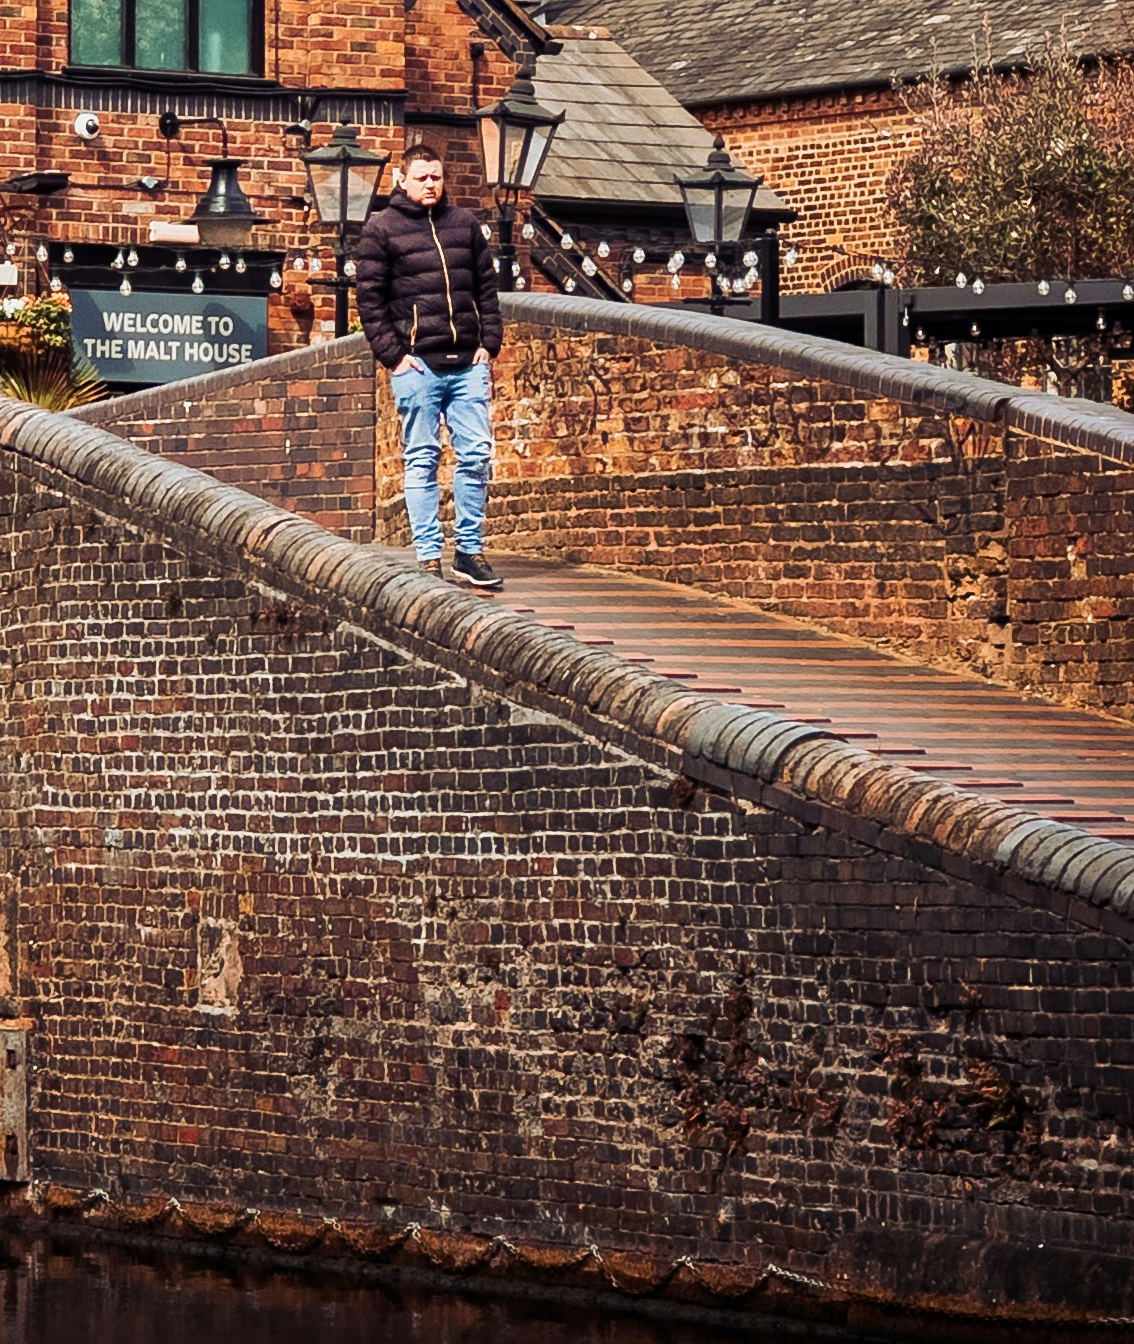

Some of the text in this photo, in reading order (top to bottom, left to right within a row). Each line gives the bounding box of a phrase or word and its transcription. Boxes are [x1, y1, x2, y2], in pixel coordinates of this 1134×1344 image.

[102, 311, 234, 337] WELCOME TO
[83, 338, 253, 364] THE MALT HOUSE
